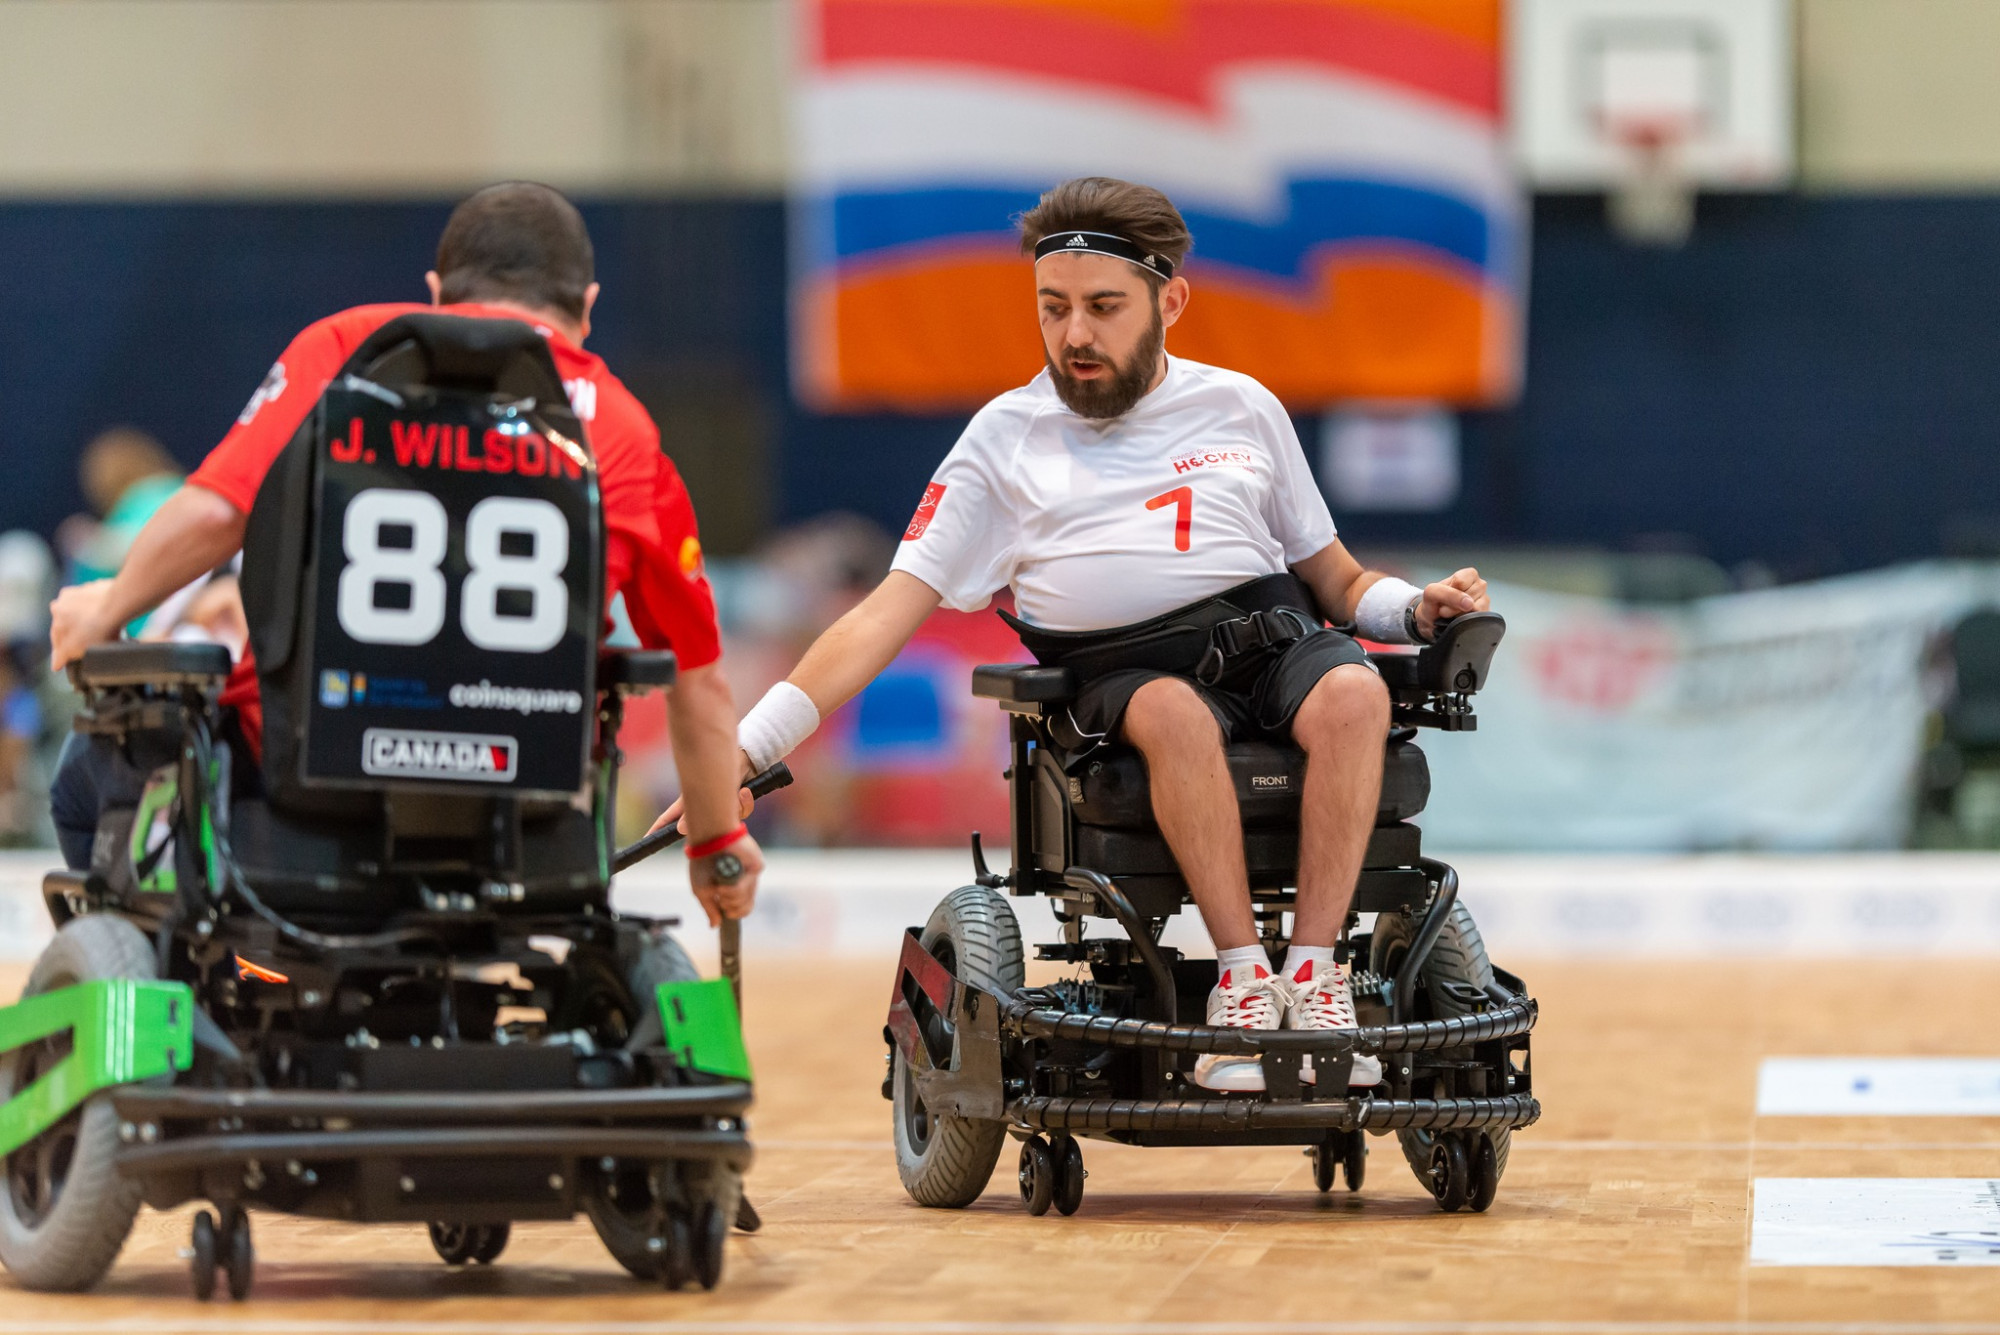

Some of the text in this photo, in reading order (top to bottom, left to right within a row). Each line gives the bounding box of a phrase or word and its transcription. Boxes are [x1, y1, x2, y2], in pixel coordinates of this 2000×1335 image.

[330, 417, 583, 480] J. WILSON
[337, 487, 569, 653] 88
[449, 678, 582, 716] coinsquare
[372, 736, 497, 773] CANADA
[1252, 776, 1288, 786] FRONT
